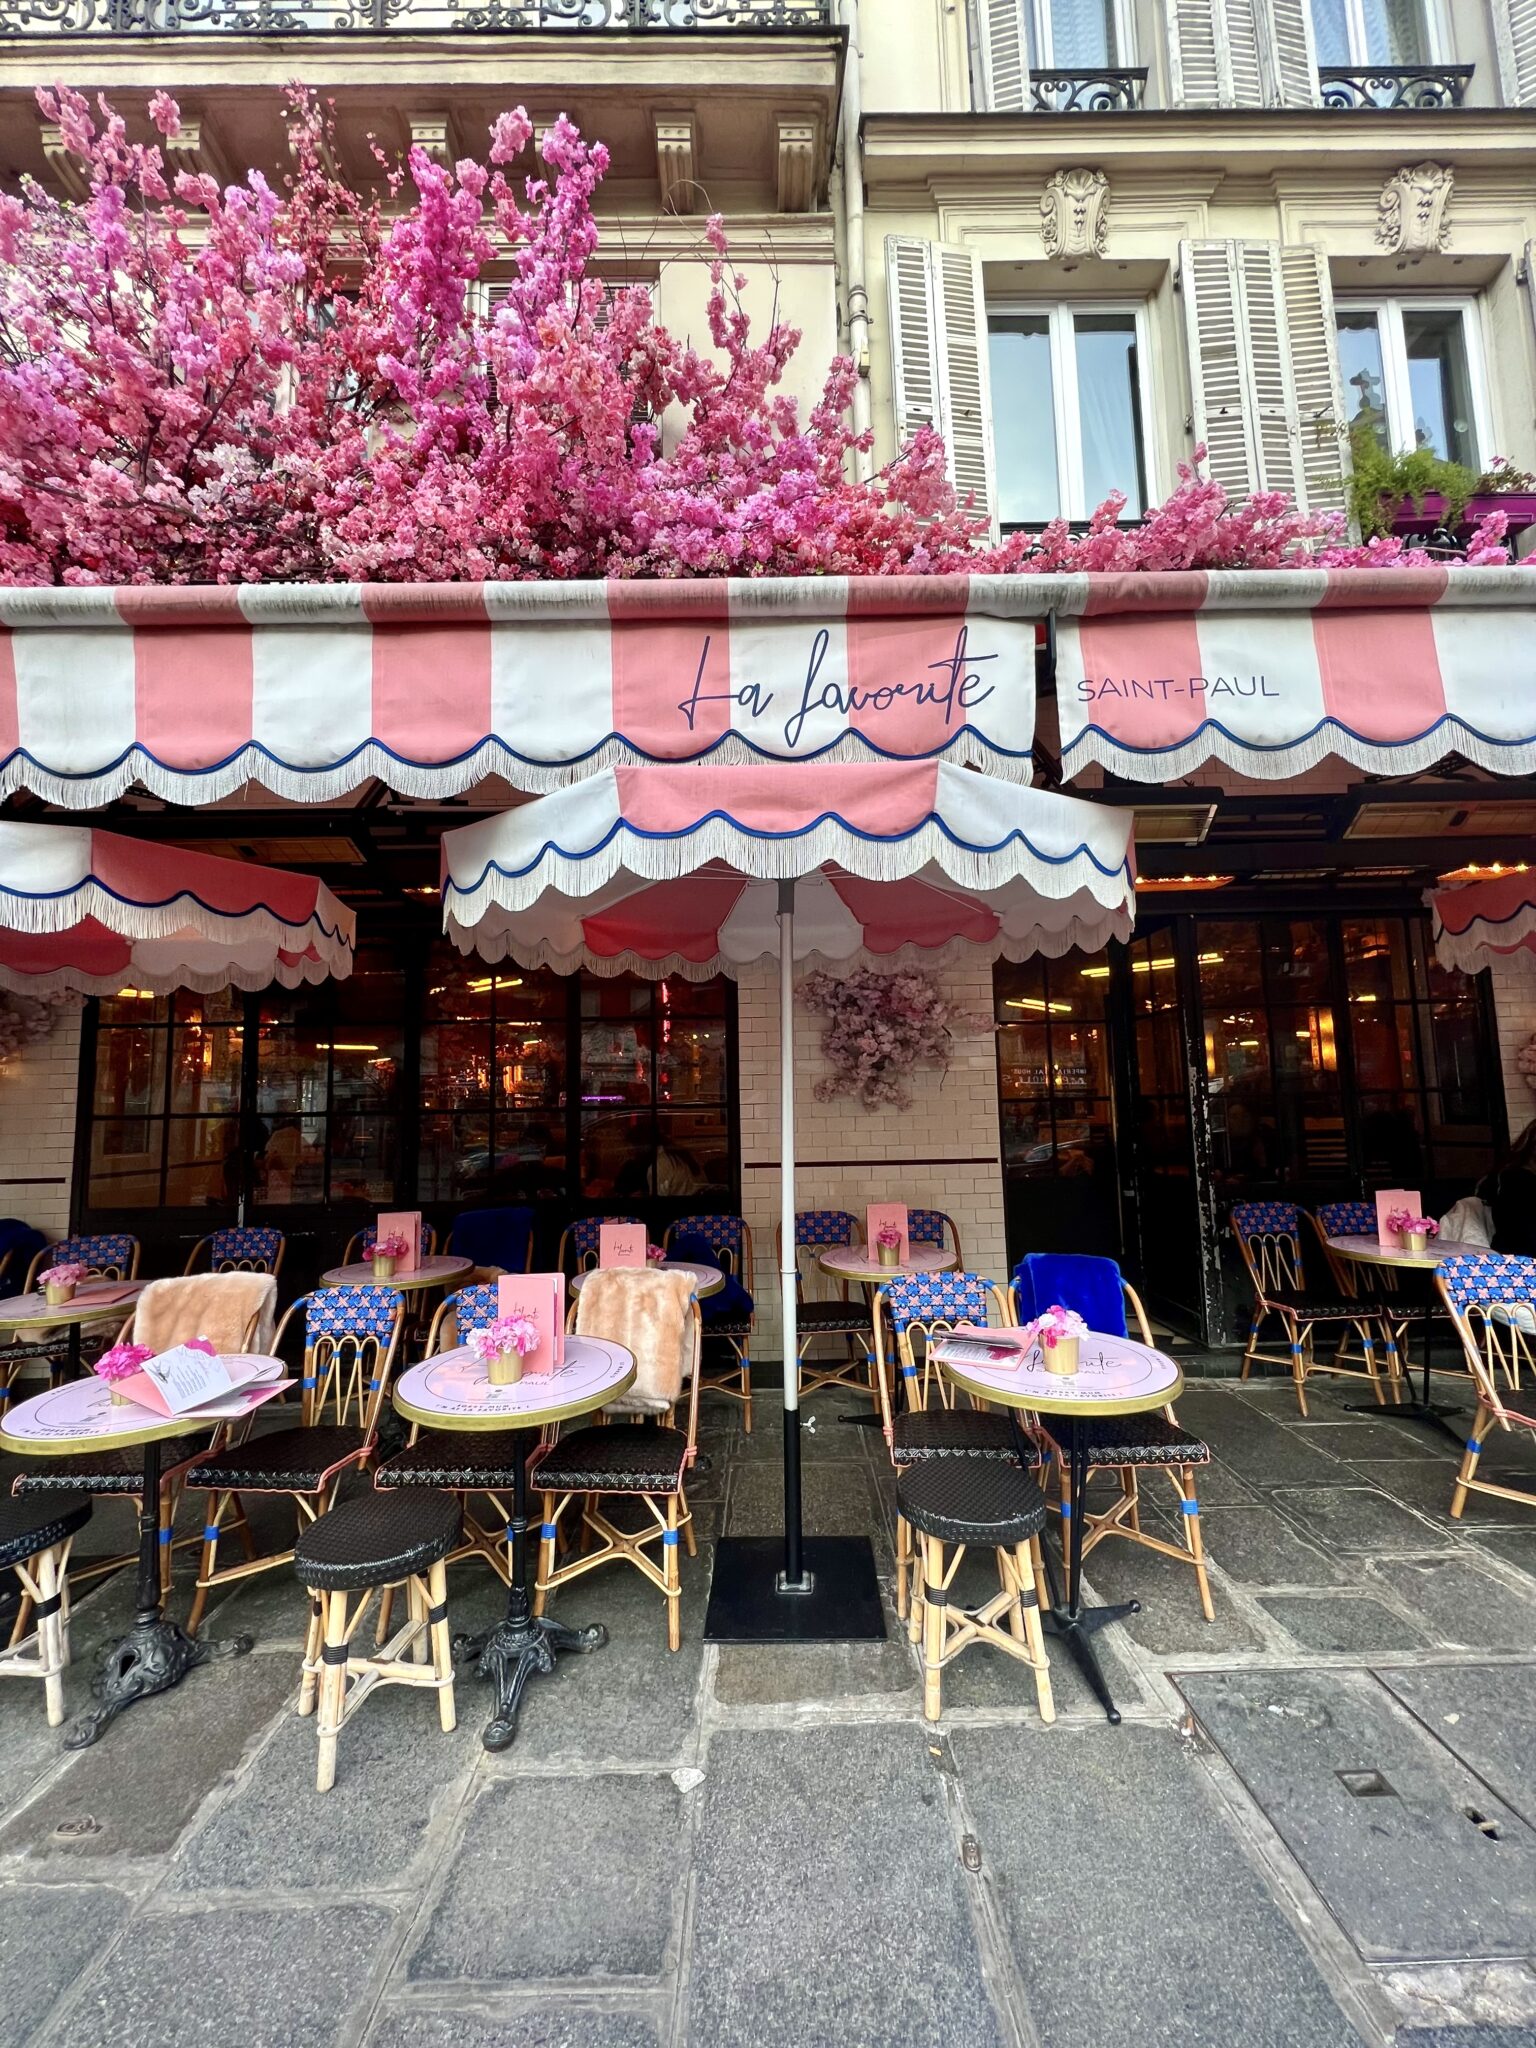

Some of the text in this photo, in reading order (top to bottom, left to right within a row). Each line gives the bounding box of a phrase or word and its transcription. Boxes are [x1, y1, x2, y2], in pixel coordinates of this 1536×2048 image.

[677, 625, 999, 748] La favorite
[1076, 675, 1281, 703] SAINT-PAUL
